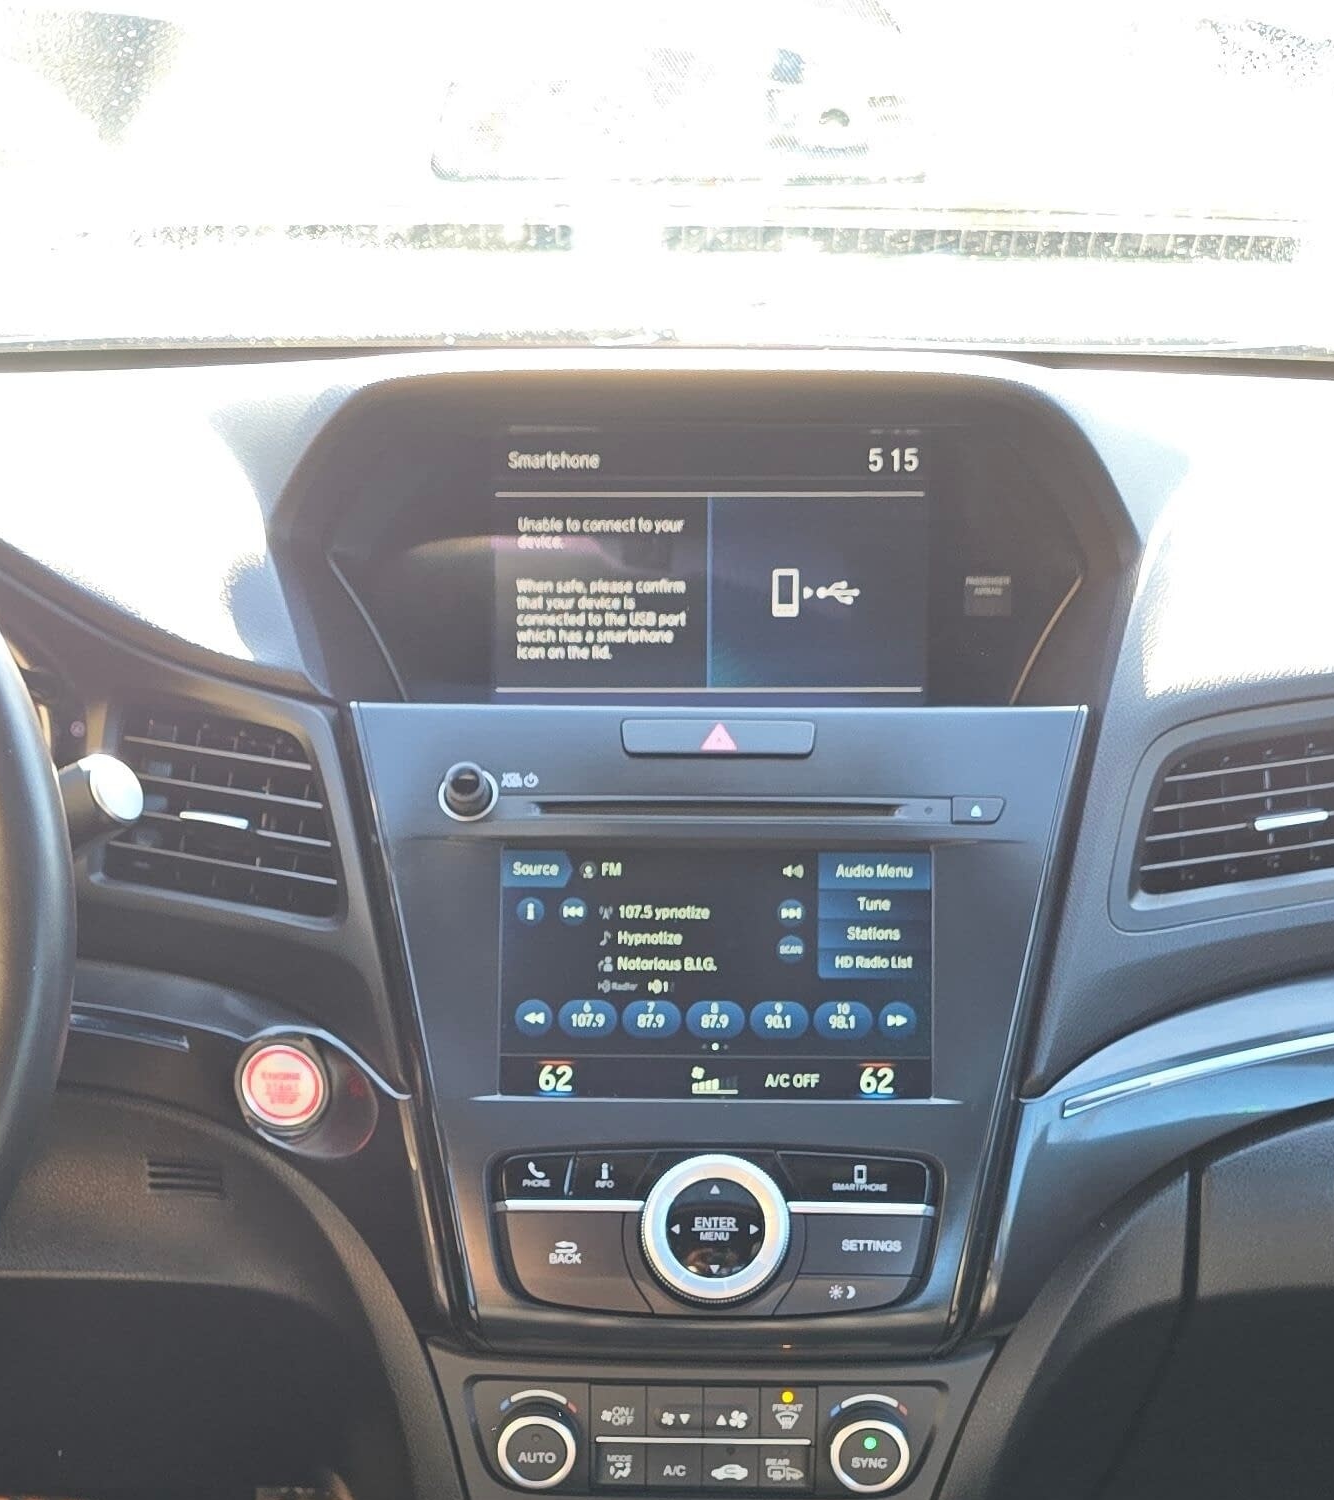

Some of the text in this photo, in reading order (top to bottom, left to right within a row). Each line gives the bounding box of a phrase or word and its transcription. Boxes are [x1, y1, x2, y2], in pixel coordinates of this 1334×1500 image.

[508, 451, 601, 470] Smartphone
[517, 516, 685, 534] Unable to connect to your
[516, 578, 554, 594] When
[589, 578, 634, 595] please
[636, 577, 687, 594] confirm
[517, 595, 636, 612] that your device is
[517, 611, 687, 628] connected to the USB port
[517, 628, 674, 645] which has a smartphone
[517, 645, 545, 659] icon
[547, 646, 565, 659] on
[567, 645, 590, 659] the
[513, 862, 560, 876] Source
[601, 862, 622, 877] FM
[836, 863, 914, 879] Audio Menu
[857, 896, 891, 911] Tune
[619, 905, 711, 921] 107.5 ypnotize
[617, 931, 683, 946] Hypnotize
[846, 926, 901, 941] Stations
[617, 956, 717, 972] Notorious B.I.G.
[835, 955, 913, 969] HD Radio List
[582, 1001, 592, 1013] 6
[646, 1001, 655, 1013] 7
[710, 1002, 719, 1014] 8
[774, 1002, 783, 1014] 9
[836, 1002, 850, 1014] 10
[571, 1013, 606, 1028] 107.9
[637, 1013, 665, 1028] 87.9
[701, 1014, 729, 1029] 87.9
[765, 1014, 792, 1029] 90.1
[828, 1014, 856, 1030] 98.1
[538, 1064, 573, 1092] 62
[764, 1073, 820, 1088] A/C OFF
[859, 1067, 895, 1094] 62
[522, 1178, 550, 1188] PHONE
[832, 1182, 887, 1192] SMARTPHONE
[694, 1216, 736, 1228] ENTER
[699, 1231, 730, 1241] MENU
[841, 1239, 902, 1252] SETTINGS
[548, 1252, 582, 1265] BACK
[772, 1403, 803, 1412] FRONT
[612, 1416, 635, 1426] OFF
[517, 1451, 557, 1464] AUTO
[607, 1454, 633, 1463] MODE
[765, 1458, 790, 1466] REAR
[851, 1456, 888, 1469] SYNC
[663, 1465, 686, 1477] A/C
